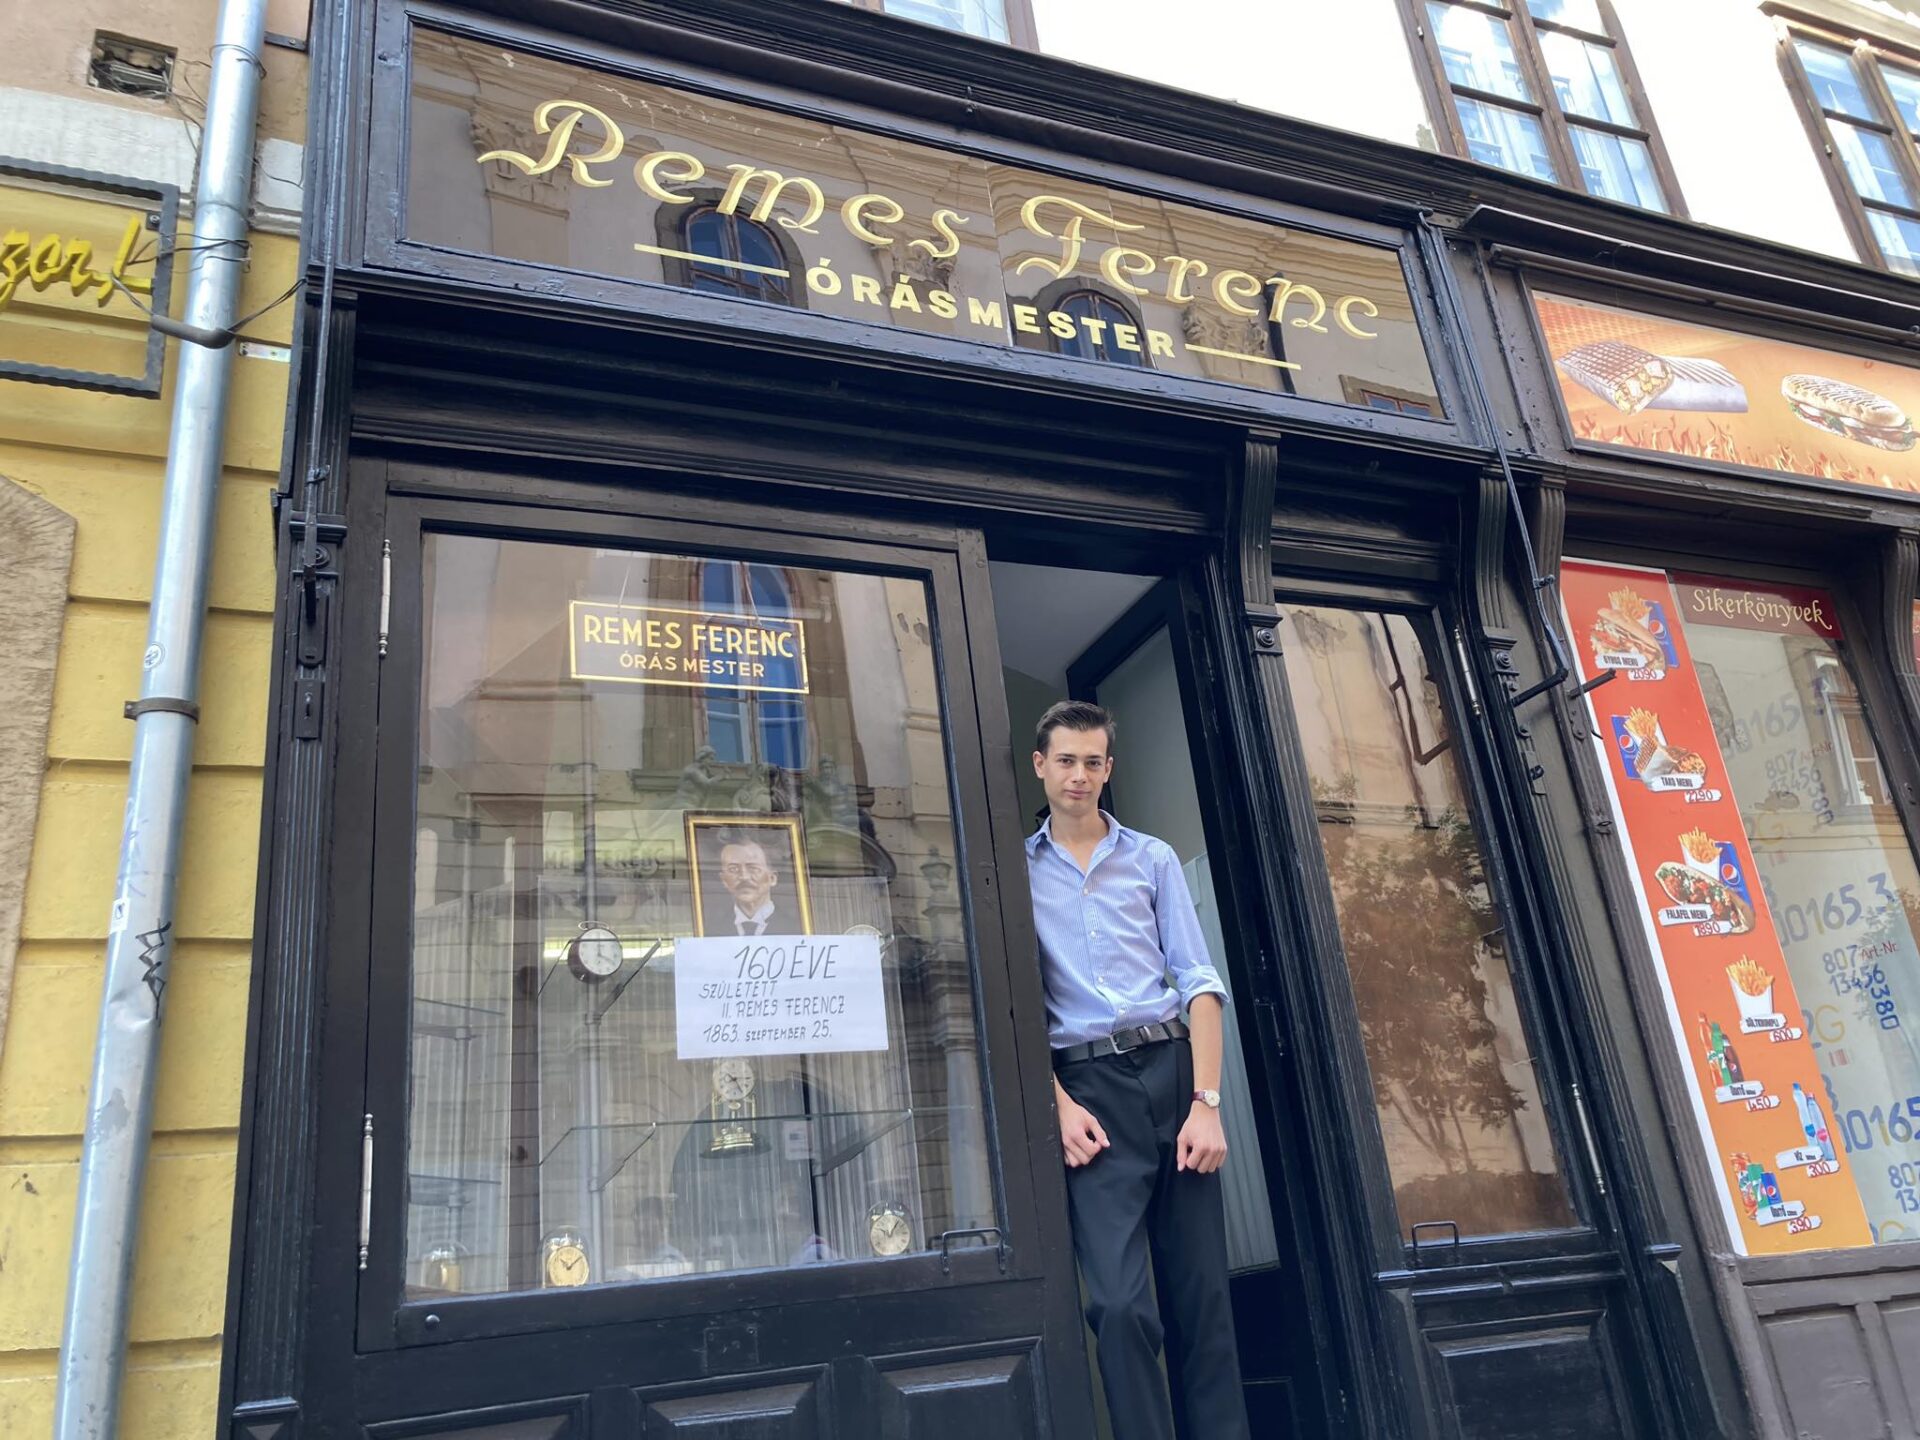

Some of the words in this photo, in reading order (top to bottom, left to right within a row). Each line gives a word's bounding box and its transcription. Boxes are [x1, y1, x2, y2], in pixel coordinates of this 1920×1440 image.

[477, 99, 969, 259] Remes
[1015, 194, 1379, 340] Ferenc
[807, 257, 1177, 359] ÓRÁSMESTER
[1692, 587, 1833, 631] Sikerkönyvek
[583, 614, 682, 649] REMES
[691, 623, 794, 658] FERENC
[619, 650, 677, 672] ÓRÁS
[683, 658, 765, 678] MESTER
[733, 945, 786, 980] 160
[789, 938, 840, 980] ÉVE
[735, 999, 779, 1018] REMES
[745, 1026, 806, 1042] SZEPTEMBER
